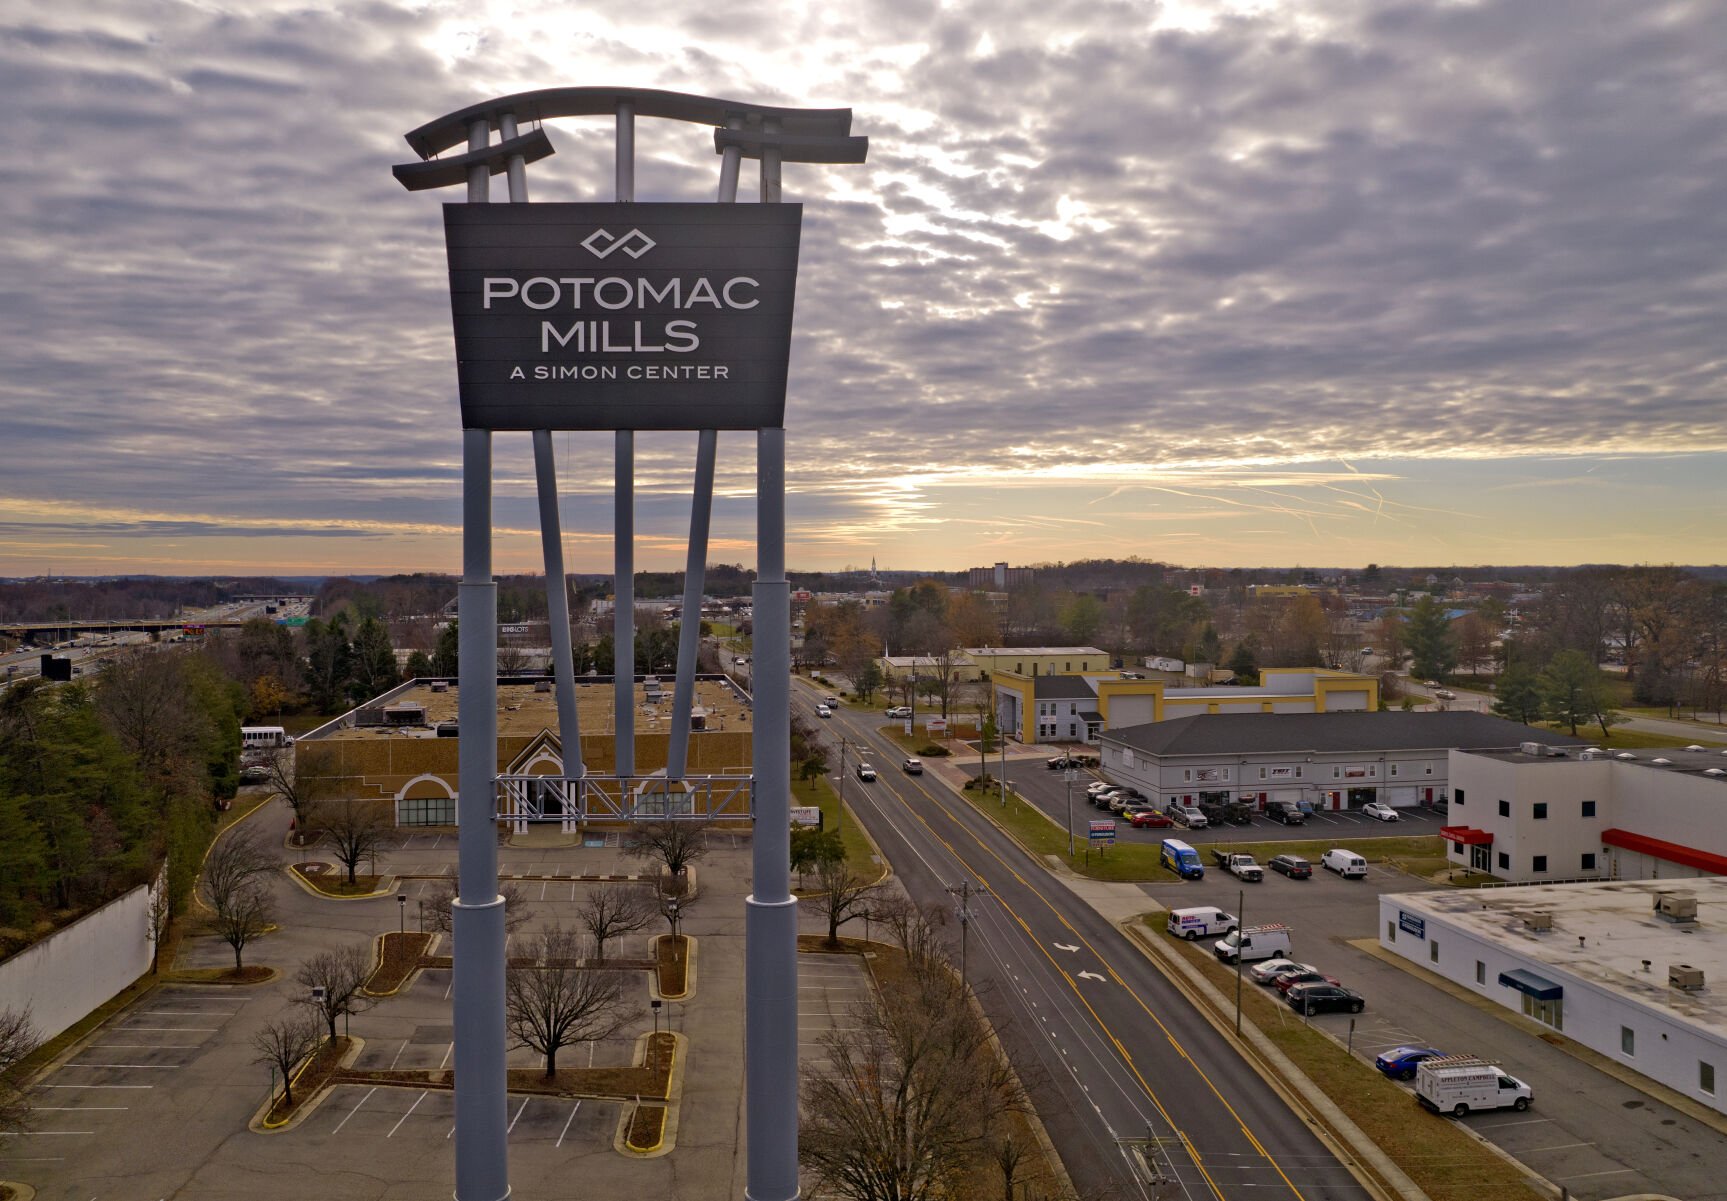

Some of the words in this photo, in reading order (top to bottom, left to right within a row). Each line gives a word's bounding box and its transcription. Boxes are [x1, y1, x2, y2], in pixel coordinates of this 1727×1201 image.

[483, 276, 760, 310] POTOMAC
[541, 319, 700, 353] MILLS
[510, 366, 525, 380] A
[534, 366, 617, 380] SIMON
[627, 366, 730, 380] CENTER
